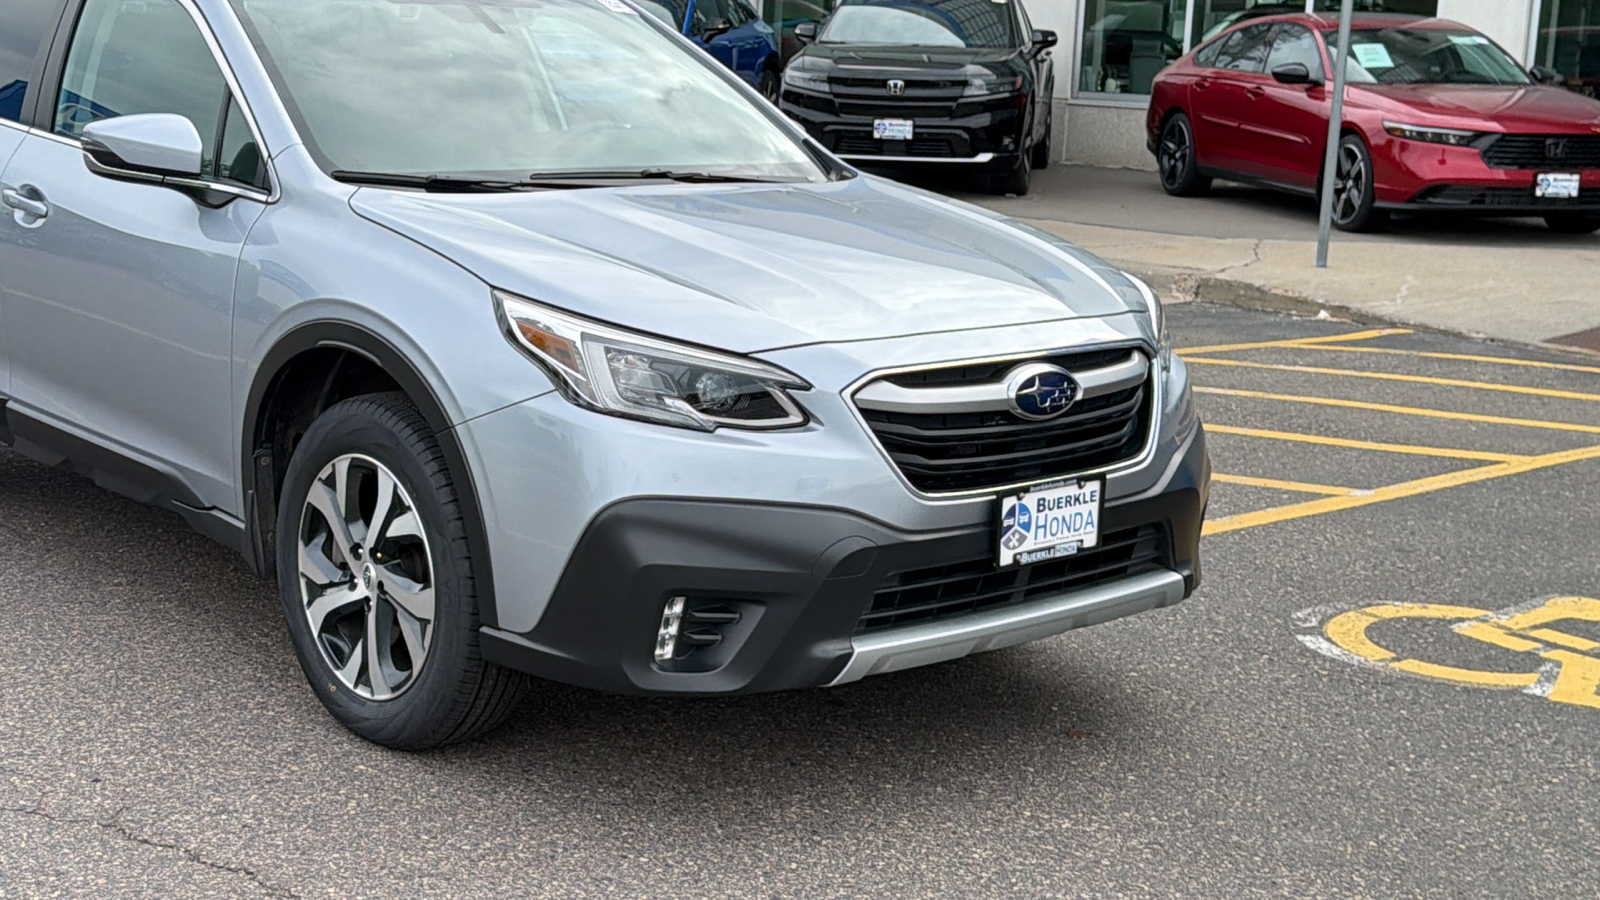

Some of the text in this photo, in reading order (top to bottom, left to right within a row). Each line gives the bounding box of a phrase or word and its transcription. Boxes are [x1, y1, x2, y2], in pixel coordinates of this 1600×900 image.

[1036, 490, 1098, 514] BUERKLE
[1034, 509, 1095, 541] HONDA
[1021, 543, 1077, 563] BUERKLE HONDA
